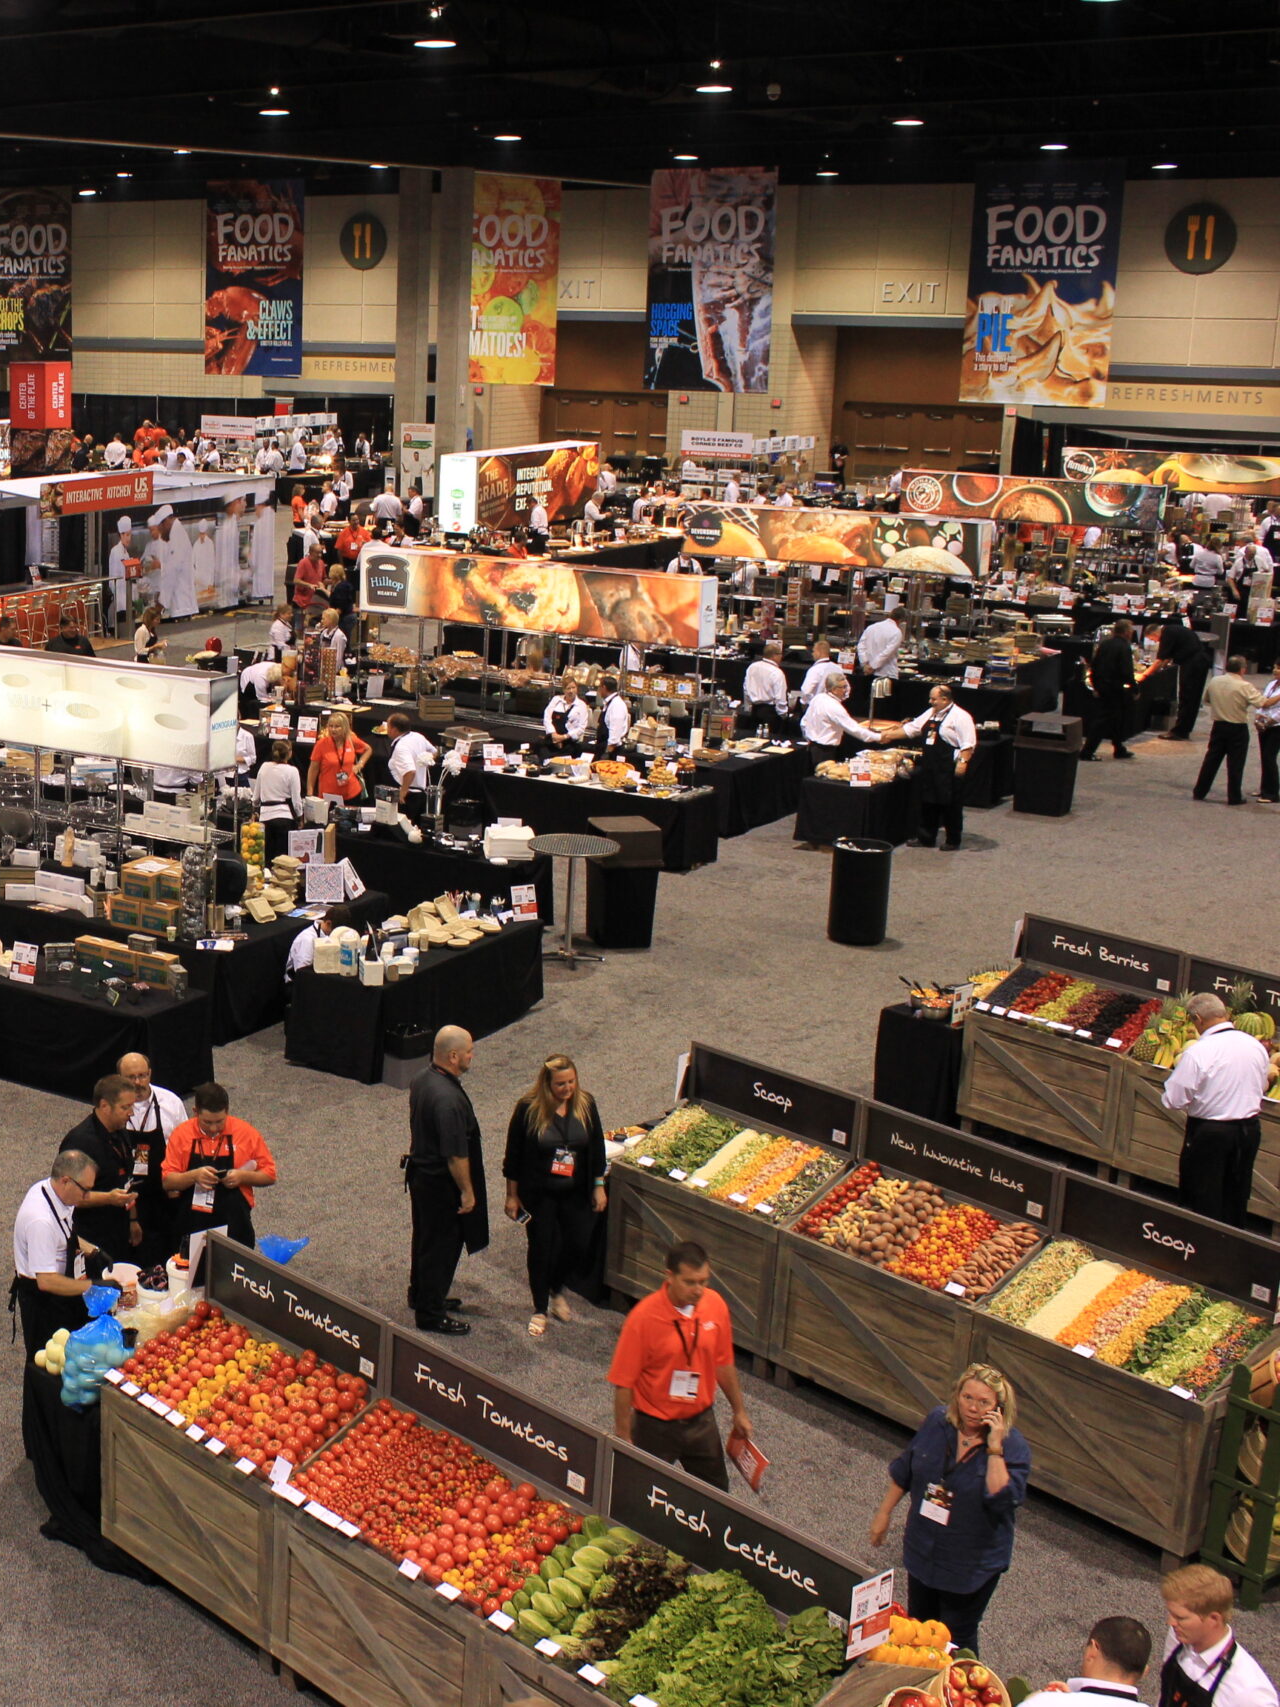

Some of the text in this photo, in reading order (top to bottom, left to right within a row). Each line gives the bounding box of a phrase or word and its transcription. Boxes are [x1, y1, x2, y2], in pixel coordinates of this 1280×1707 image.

[216, 212, 294, 244] FOOD
[660, 205, 765, 243] FOOD
[986, 204, 1107, 245] FOOD
[218, 243, 292, 263] FANATICS
[472, 248, 546, 268] ANATICS
[662, 243, 762, 265] FANATICS
[987, 245, 1102, 268] FANATICS
[560, 279, 595, 299] XIT
[882, 282, 940, 304] EXIT
[10, 298, 24, 312] THE
[258, 300, 293, 320] CLAWS
[651, 303, 693, 321] HOGGING
[258, 320, 293, 340] EFFECT
[650, 319, 680, 336] SPACE
[976, 313, 1014, 352] PIE
[314, 360, 395, 373] REFRESHMEN
[19, 382, 27, 409] CENTER
[1112, 386, 1263, 405] REFRESHMENTS
[28, 410, 35, 419] OF
[58, 409, 65, 418] OF
[485, 470, 499, 483] THE
[516, 465, 548, 481] INTEGRITY.
[1066, 460, 1094, 475] RITUALS
[66, 484, 131, 505] INTERACTIVE KITCHEN
[478, 478, 509, 503] GRADE
[516, 479, 553, 496] REPUTATION.
[515, 494, 549, 511] EXPISE.
[691, 528, 720, 536] DEVONSHIRE
[370, 575, 404, 593] Hilltop
[211, 719, 237, 732] MONOGRAM
[1052, 935, 1150, 973] Fresh Berries
[1212, 976, 1257, 1000] Frh
[753, 1081, 792, 1113] Scoop
[890, 1132, 917, 1155] New,
[1142, 1222, 1196, 1261] Scoop
[231, 1263, 360, 1349] Fresh Tomatoes
[414, 1362, 568, 1462] Fresh Tomatoes
[647, 1484, 819, 1596] Fresh Lettuce
